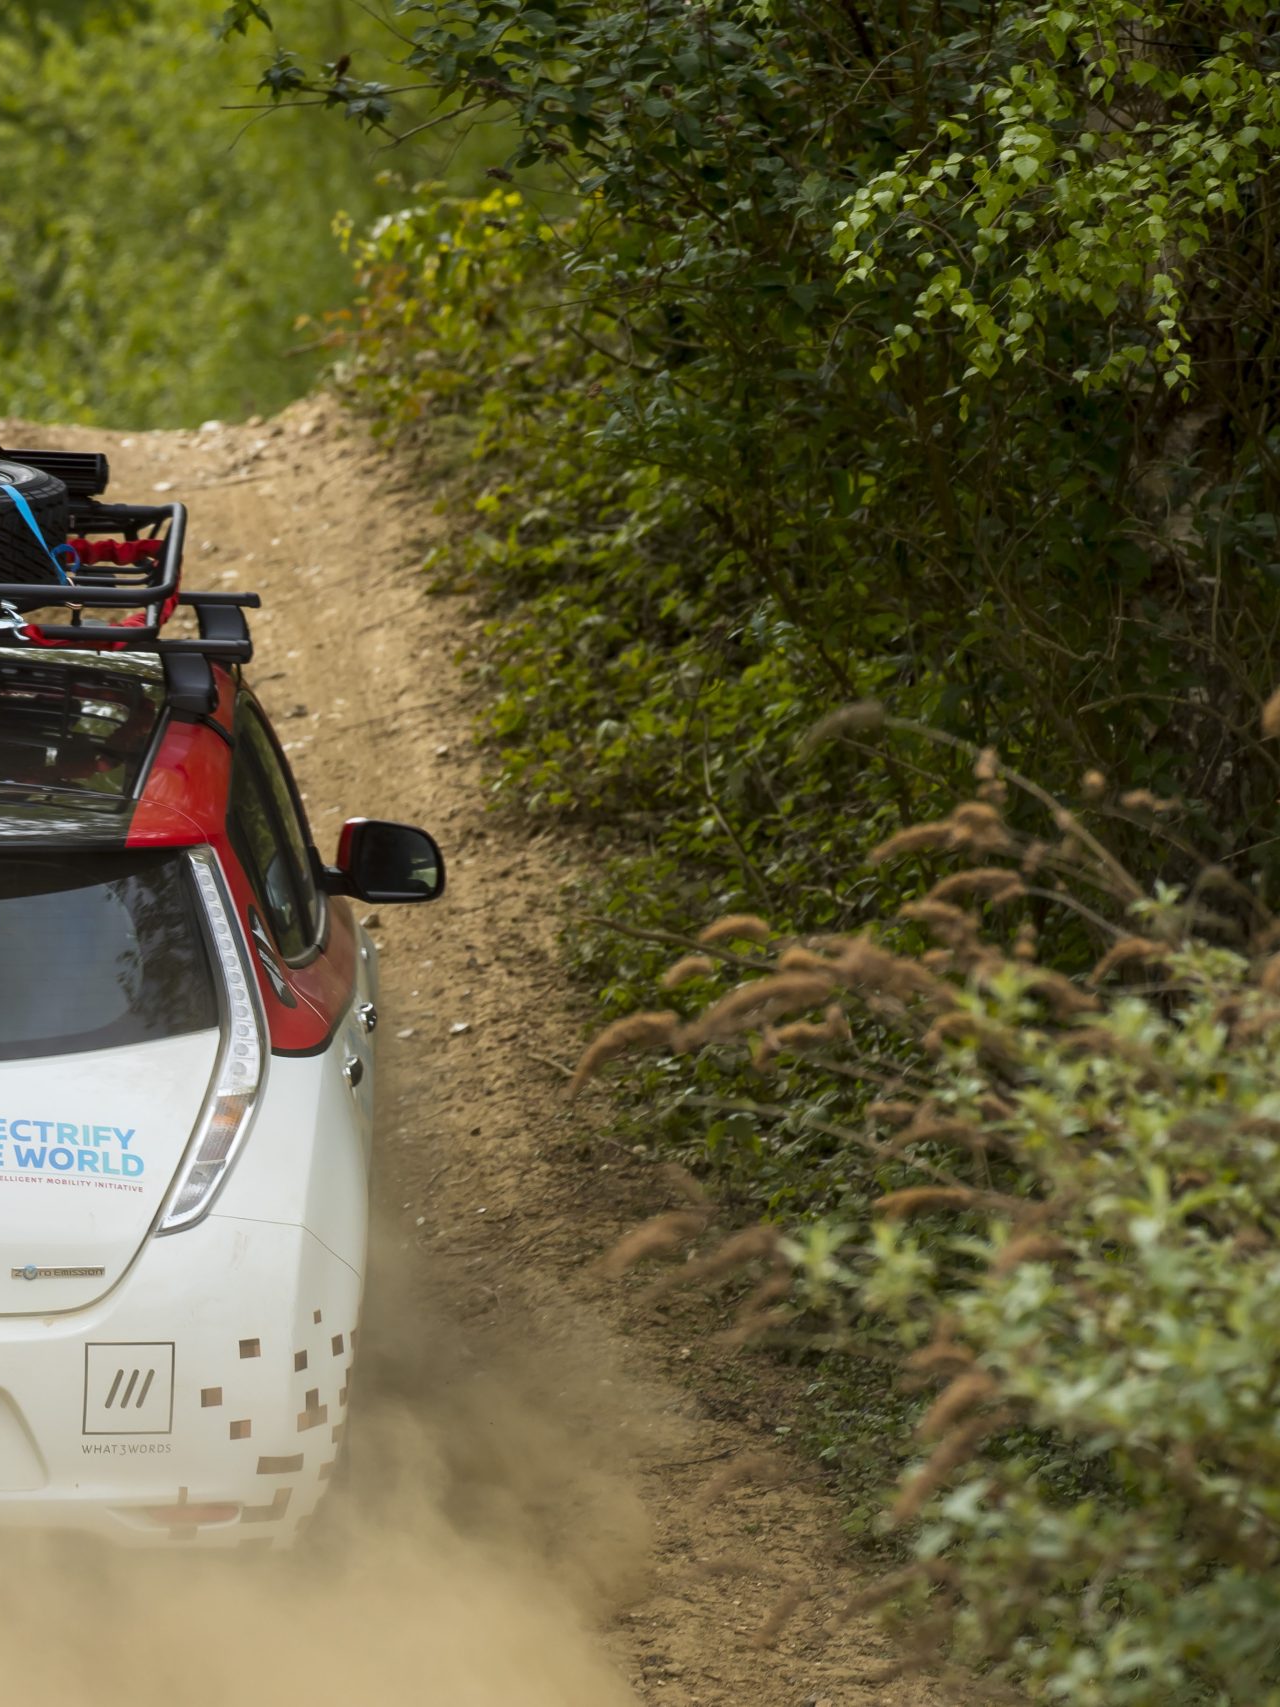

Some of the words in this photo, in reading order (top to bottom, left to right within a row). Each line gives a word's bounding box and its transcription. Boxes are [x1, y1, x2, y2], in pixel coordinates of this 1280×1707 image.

[13, 1144, 145, 1177] WORLD
[46, 1178, 92, 1187] MOBILITY
[94, 1181, 144, 1193] INITIATIVE
[81, 1443, 172, 1456] WHAT3WORDS
